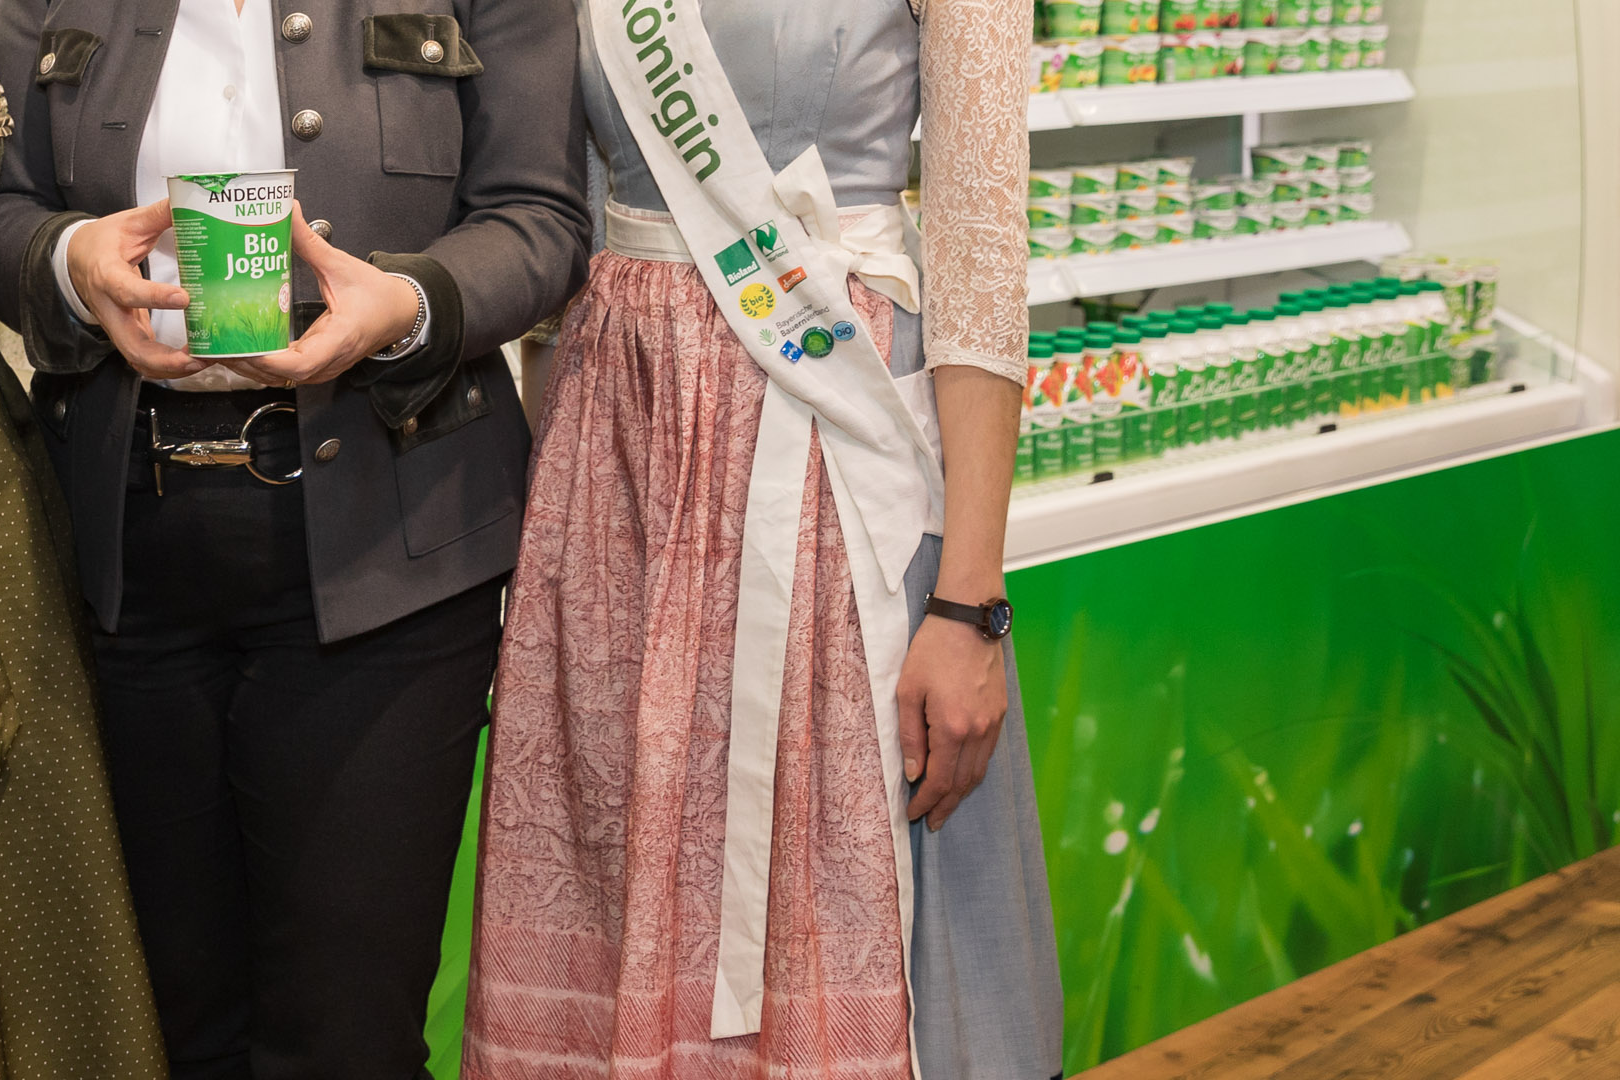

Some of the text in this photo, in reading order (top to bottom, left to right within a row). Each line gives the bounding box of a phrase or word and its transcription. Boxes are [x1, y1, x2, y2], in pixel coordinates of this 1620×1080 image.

[208, 185, 293, 203] ANDECHSER
[235, 202, 283, 217] NATUR
[244, 233, 279, 255] Bio
[224, 250, 289, 281] Jogurt
[726, 260, 758, 284] Bioland
[748, 295, 764, 306] bio
